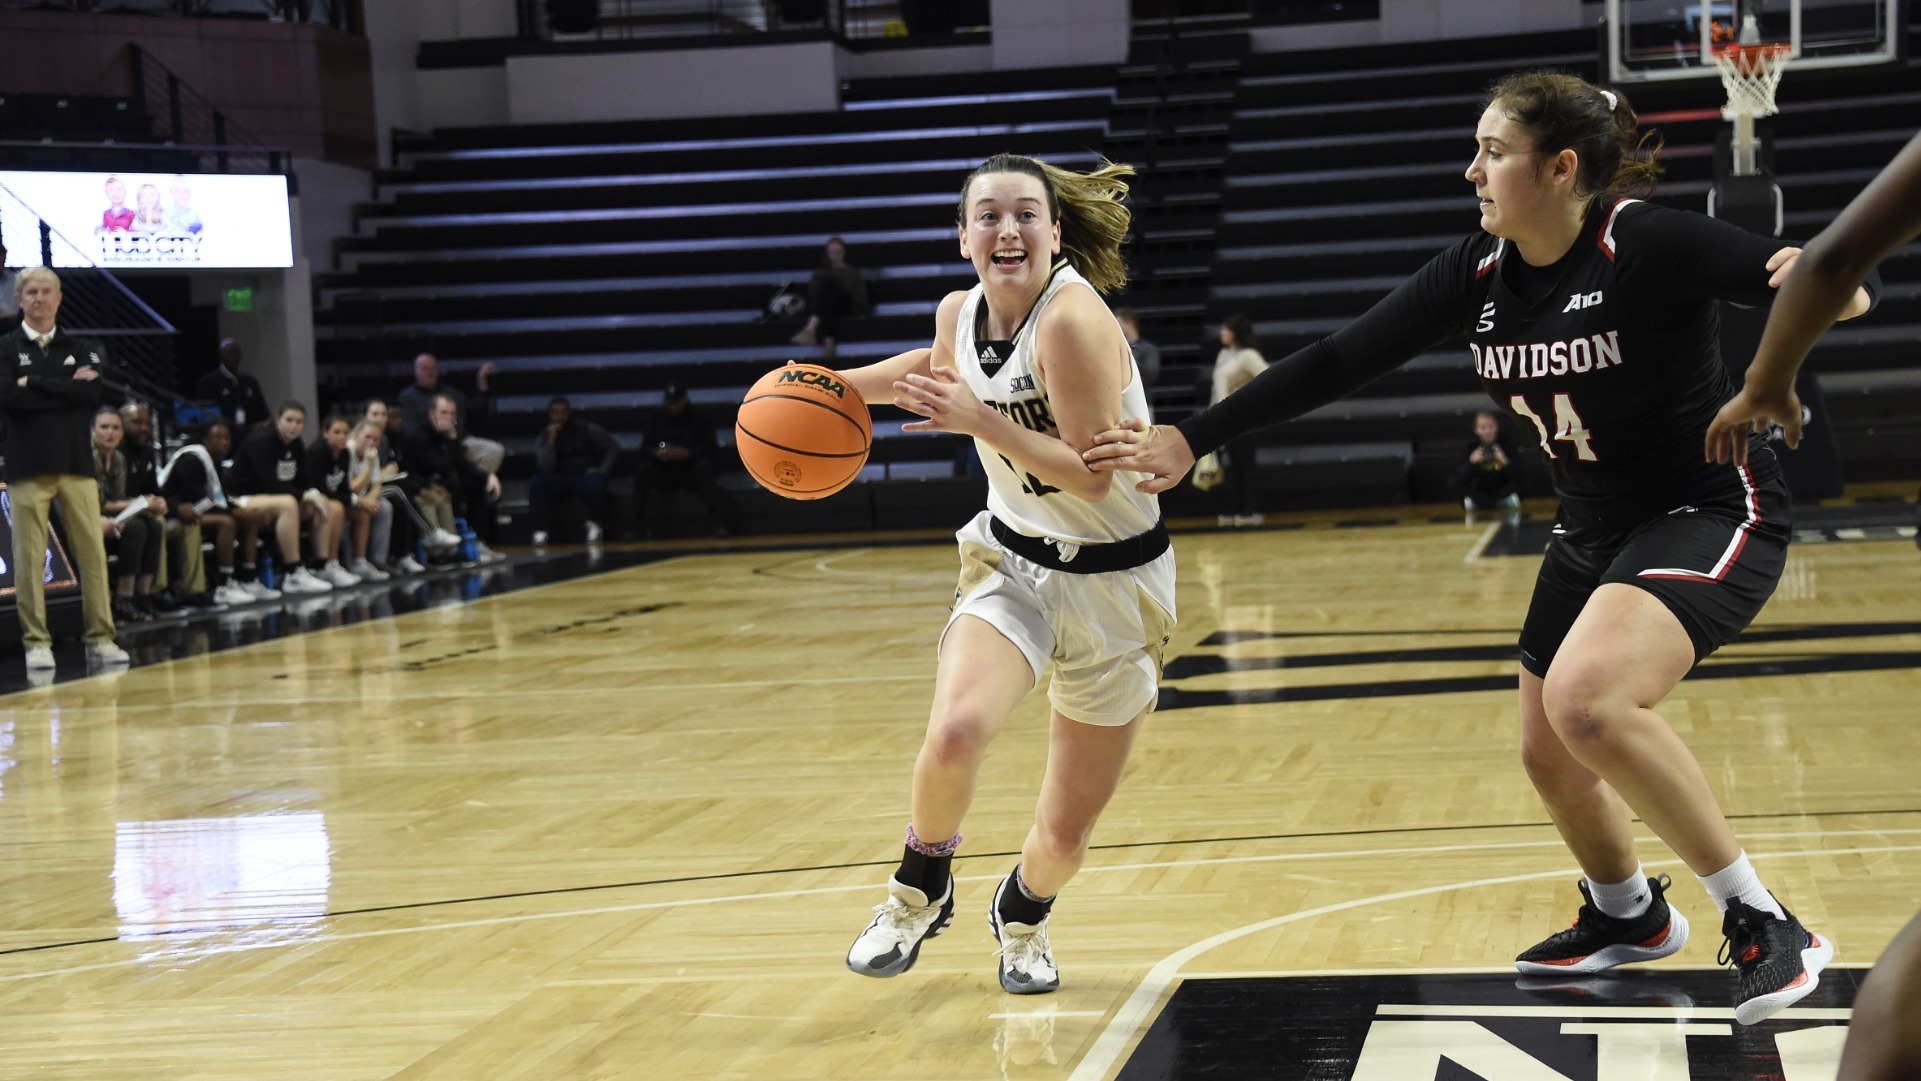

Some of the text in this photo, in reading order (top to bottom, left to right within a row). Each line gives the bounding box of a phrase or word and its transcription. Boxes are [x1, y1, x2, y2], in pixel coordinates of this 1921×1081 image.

[1562, 290, 1603, 313] A10
[980, 356, 1002, 364] adidas
[1469, 330, 1623, 379] DAVIDSON
[777, 370, 846, 399] NCAA
[1510, 392, 1599, 462] 14
